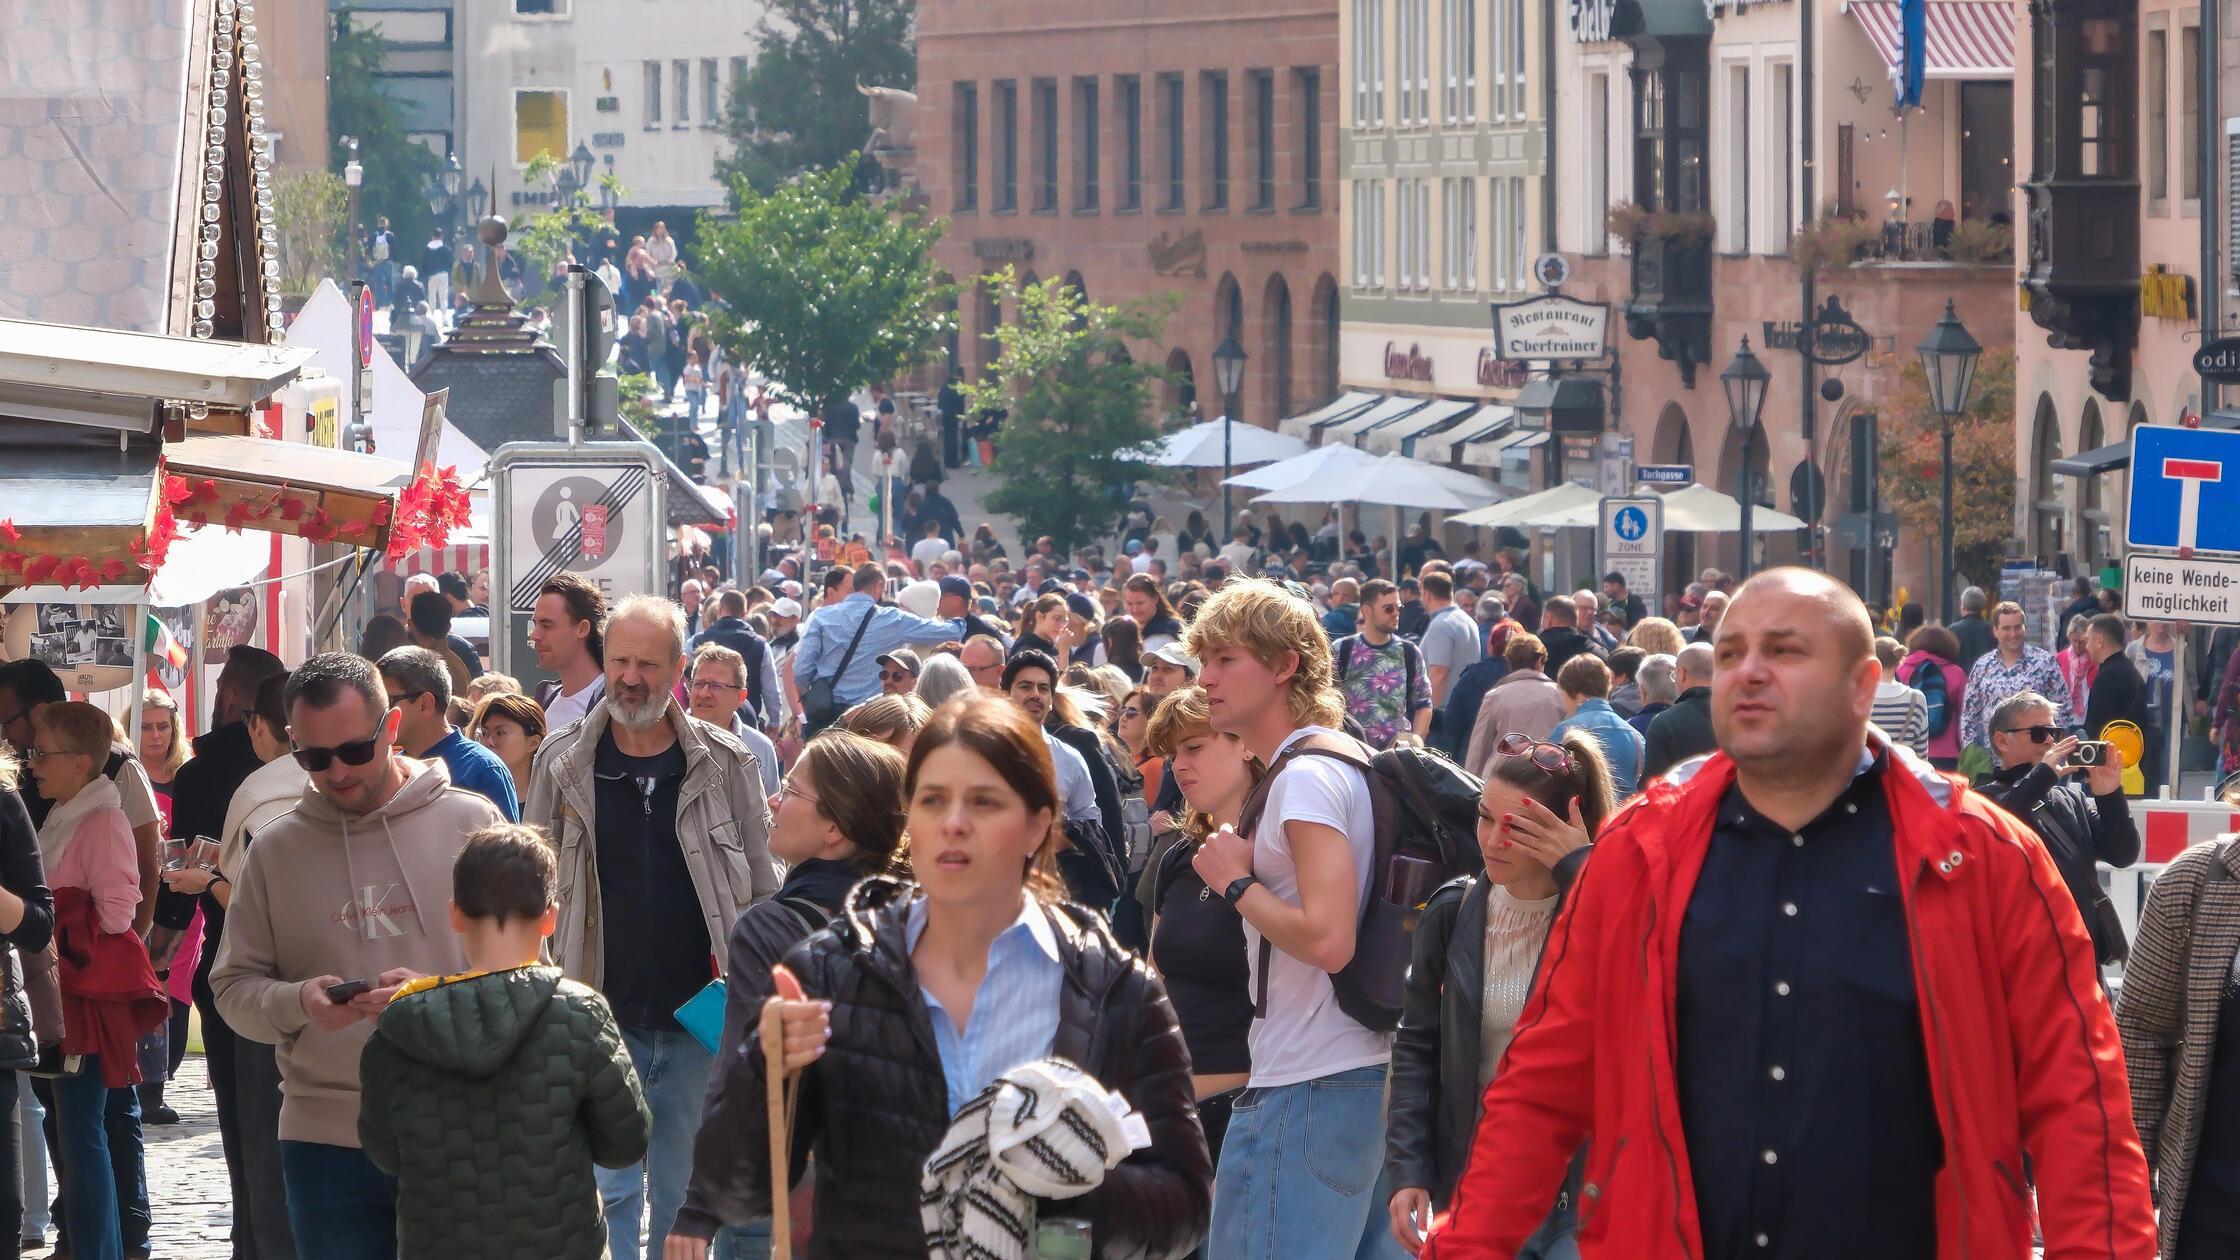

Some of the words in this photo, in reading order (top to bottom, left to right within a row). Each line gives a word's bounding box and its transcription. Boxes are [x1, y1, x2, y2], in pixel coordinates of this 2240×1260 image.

[1510, 310, 1595, 328] Restaurant
[1642, 469, 1684, 482] Tuchgasse
[1618, 542, 1644, 552] ZONE
[2134, 566, 2174, 585] keine
[2182, 569, 2238, 588] Wende-
[2142, 591, 2229, 614] möglichkeit
[206, 630, 235, 654] artufo
[361, 907, 385, 917] Klein
